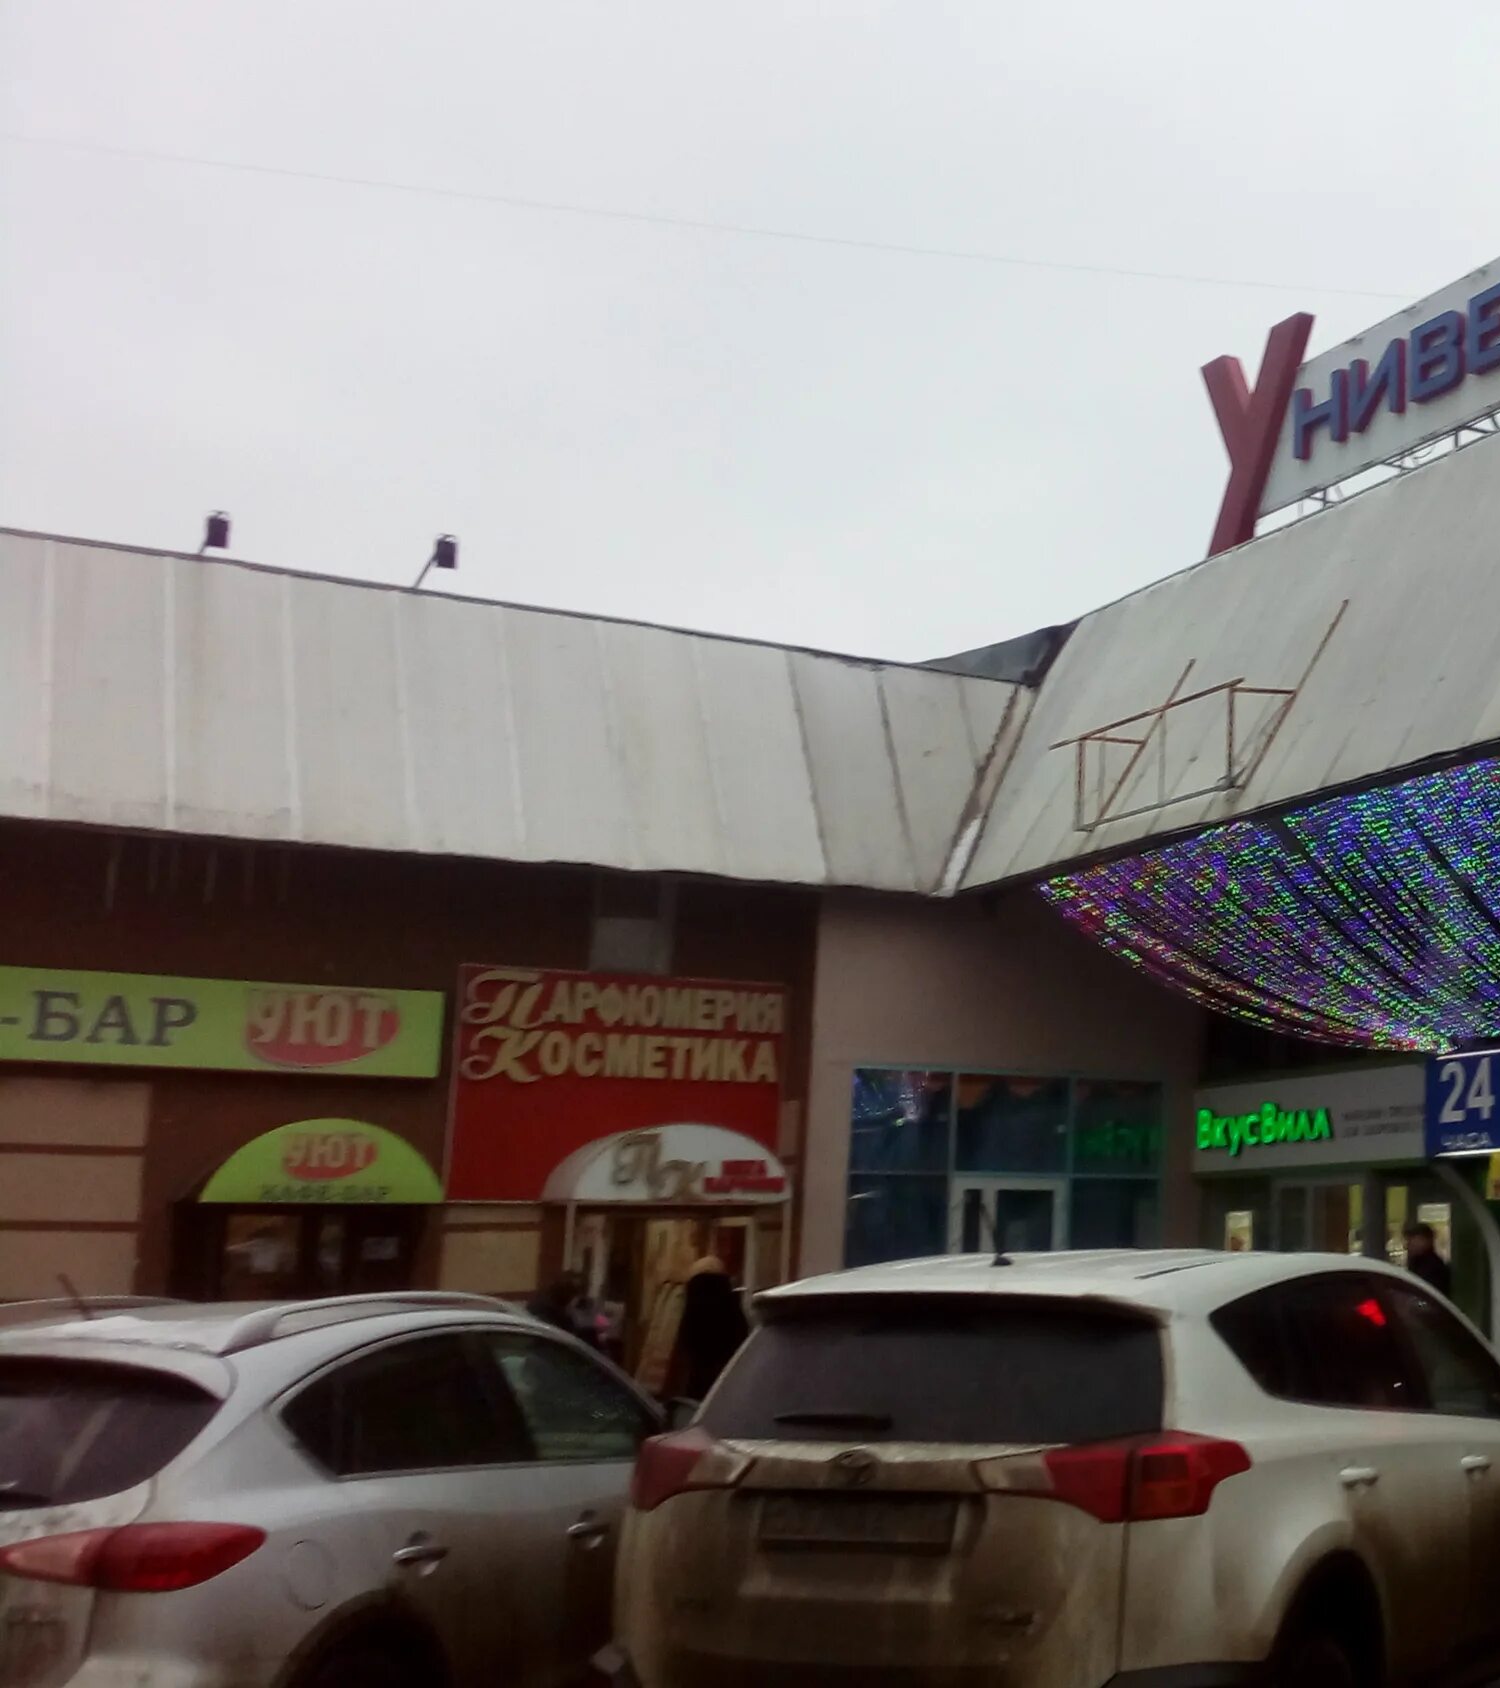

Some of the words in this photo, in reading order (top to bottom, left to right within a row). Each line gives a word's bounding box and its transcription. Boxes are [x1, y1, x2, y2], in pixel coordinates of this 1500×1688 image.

[460, 968, 784, 1034] ПАРФЮМЕРИЯ
[459, 1026, 779, 1084] КОСМЕТИКА
[1438, 1057, 1495, 1124] 24
